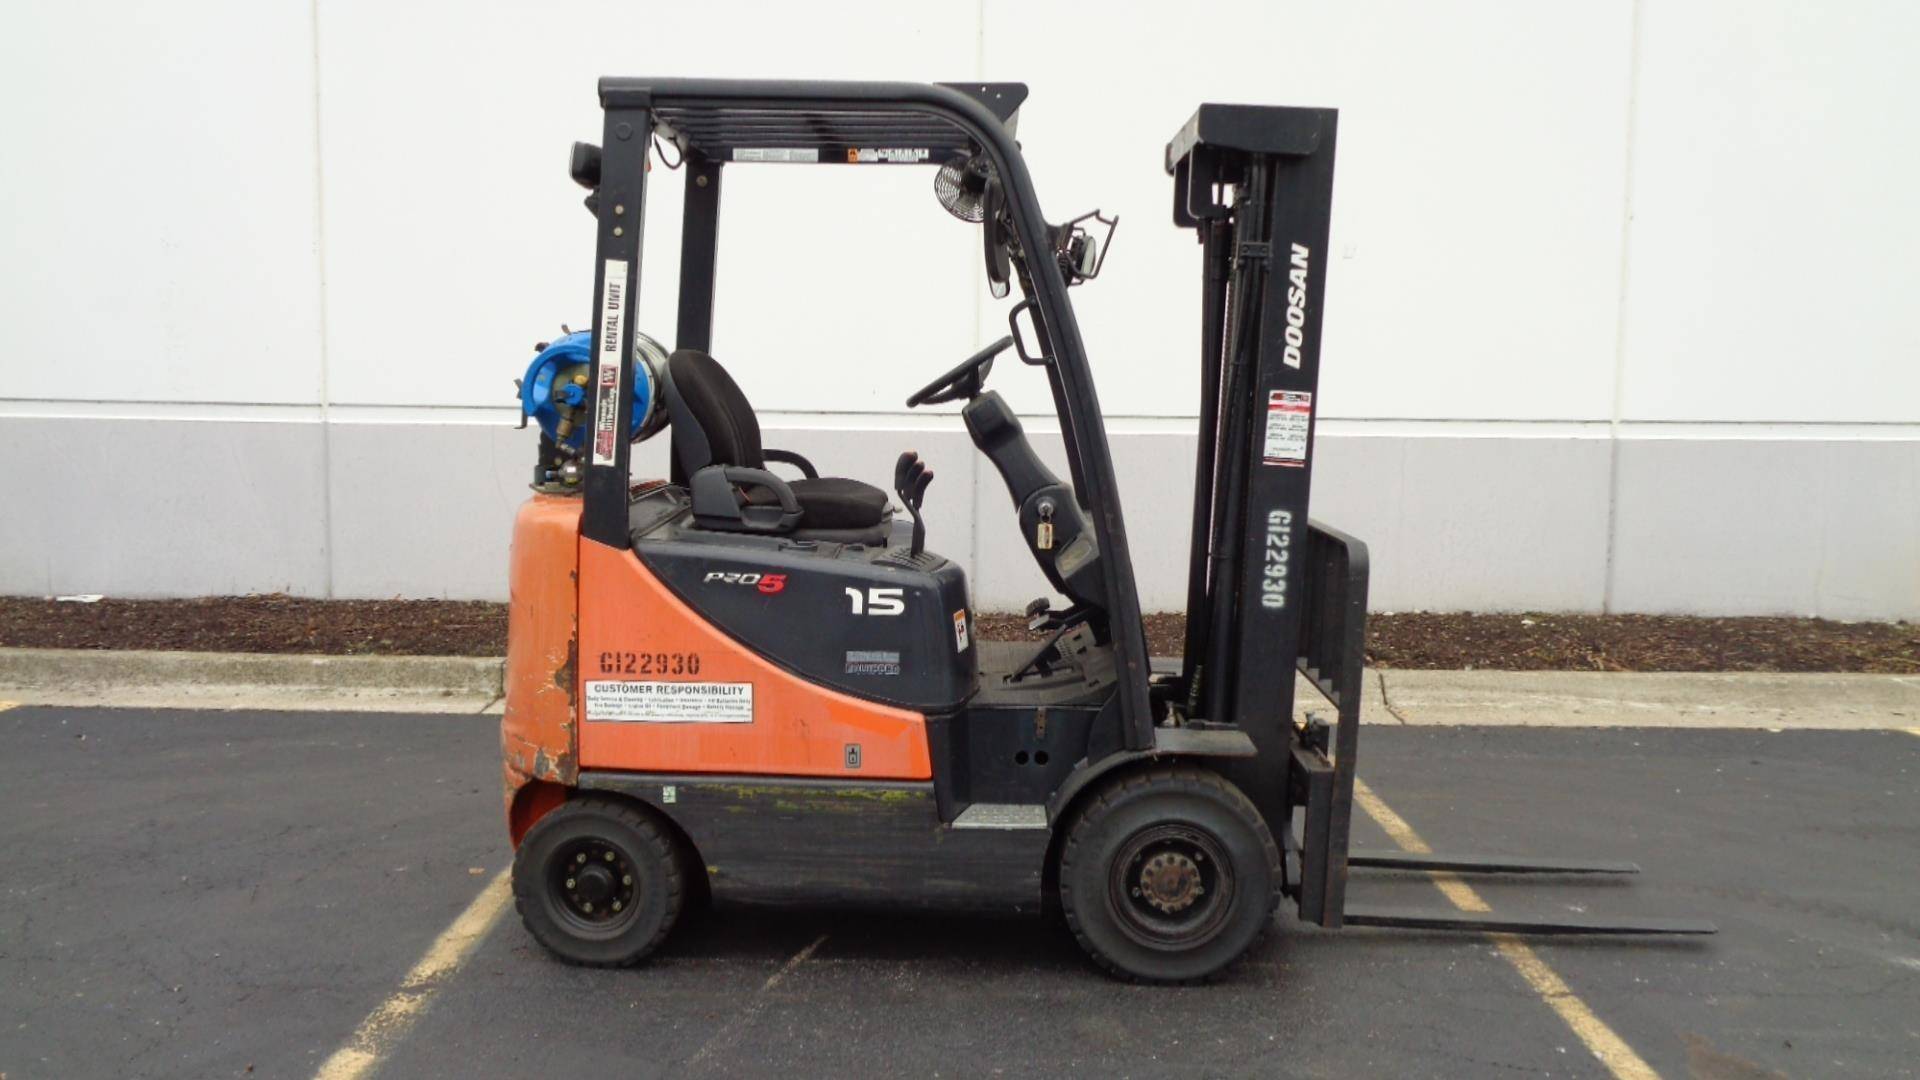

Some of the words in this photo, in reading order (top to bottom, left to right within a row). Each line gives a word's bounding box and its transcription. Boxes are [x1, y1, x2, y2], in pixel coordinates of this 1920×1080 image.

[607, 282, 621, 310] UNIT
[1283, 242, 1309, 370] DOOSAN
[604, 314, 619, 352] RENTAL
[845, 587, 905, 616] 15
[594, 683, 653, 694] CUSTOMER
[656, 684, 745, 696] RESPONSIBILITY
